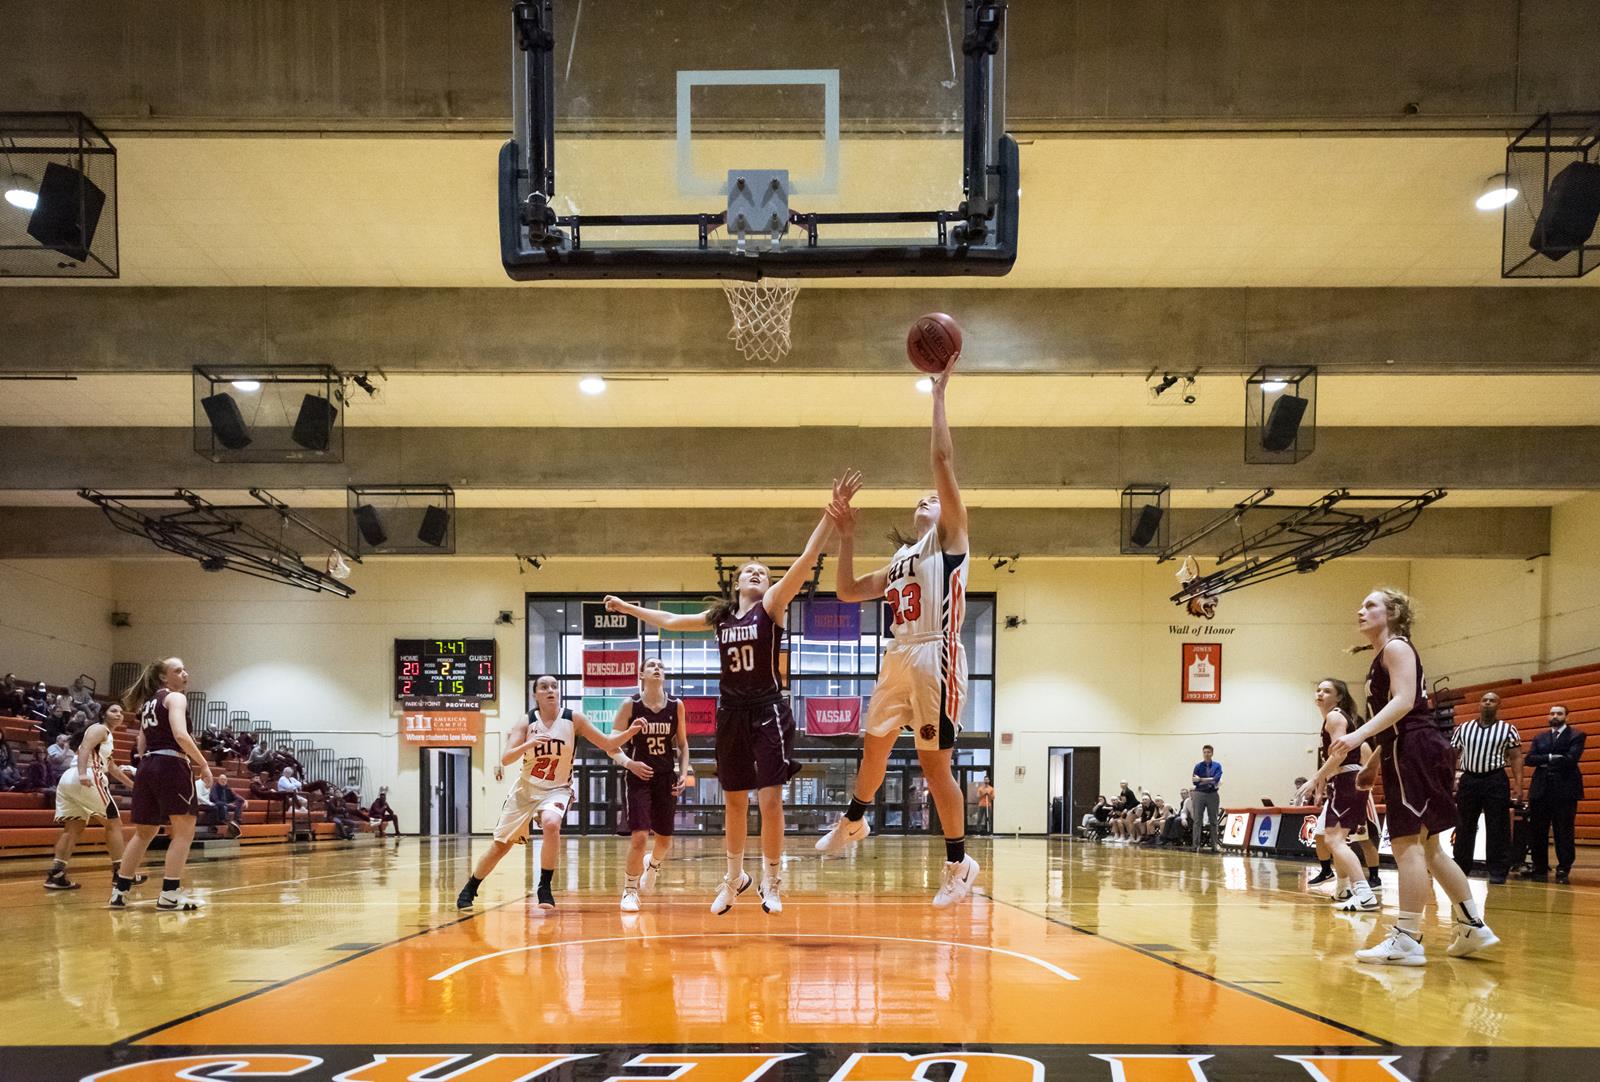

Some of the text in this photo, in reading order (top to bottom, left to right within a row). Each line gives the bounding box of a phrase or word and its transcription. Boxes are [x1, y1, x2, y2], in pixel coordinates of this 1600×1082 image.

[887, 582, 922, 625] 23
[594, 615, 628, 628] BARD
[721, 624, 758, 644] UNION
[1169, 625, 1235, 636] Wall of Honor
[435, 641, 465, 654] 7:47
[727, 645, 755, 673] 30
[403, 662, 420, 675] 20
[441, 662, 450, 675] 2
[479, 662, 491, 675] 17
[586, 662, 636, 676] RENSSELAER
[403, 681, 412, 693] 2
[438, 681, 464, 693] 1 15
[586, 709, 615, 723] SKIDM
[816, 710, 852, 723] VASSAR
[641, 722, 671, 735] UNION
[646, 736, 666, 756] 25
[530, 757, 560, 782] 21
